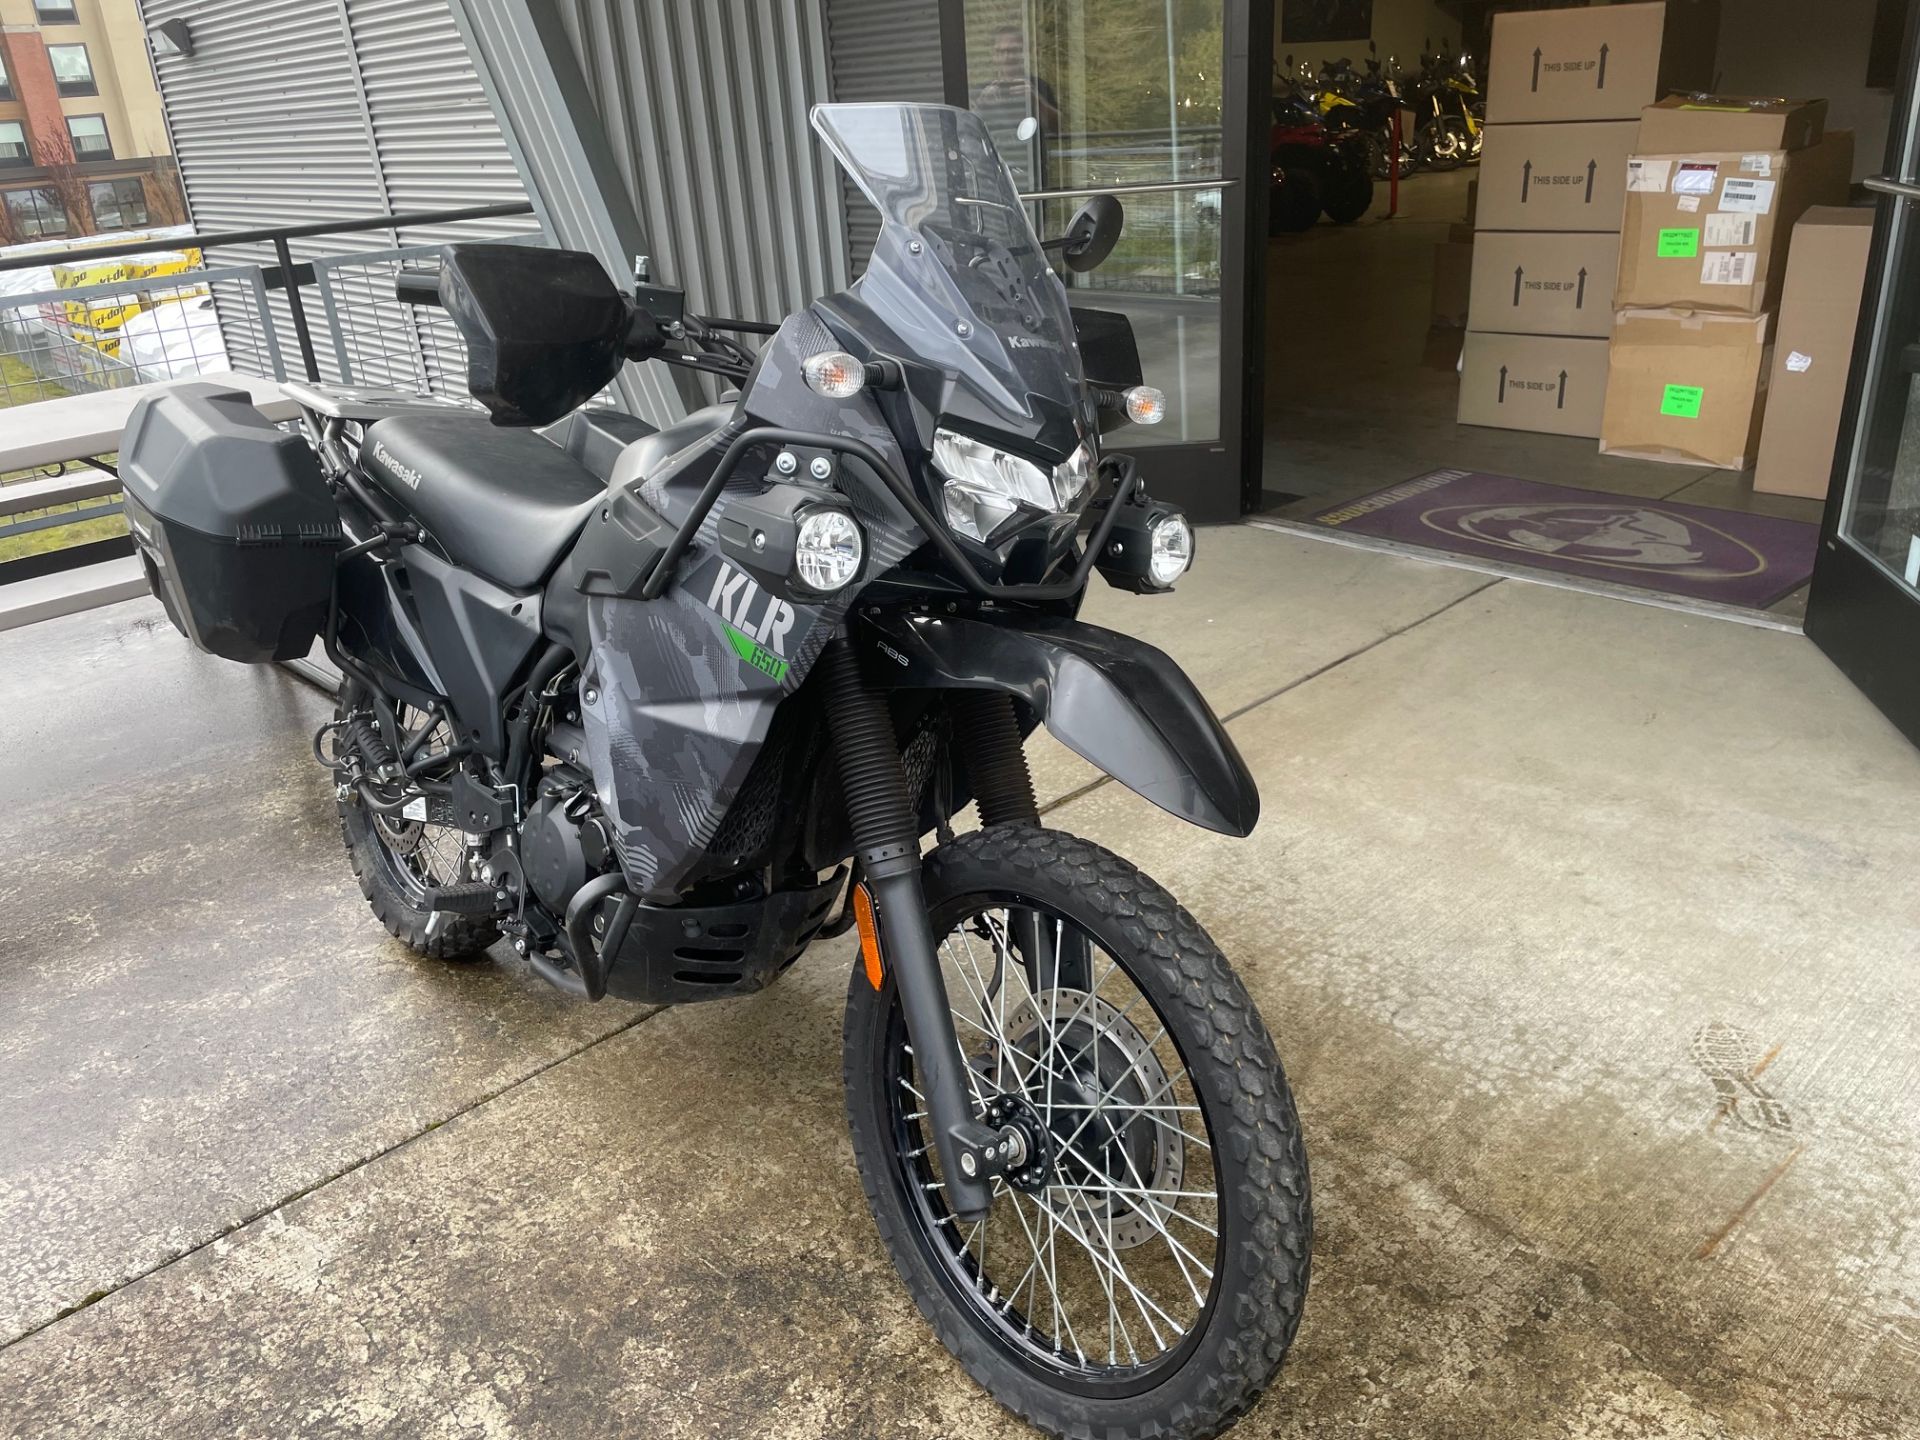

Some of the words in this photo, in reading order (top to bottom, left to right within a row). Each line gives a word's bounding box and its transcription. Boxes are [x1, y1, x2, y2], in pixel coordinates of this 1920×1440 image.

[1543, 63, 1561, 72] THIS
[1563, 61, 1583, 71] SIDE
[1584, 61, 1596, 70] UP
[1533, 176, 1551, 185] THIS
[1552, 176, 1571, 185] SIDE
[1572, 176, 1584, 185] UP
[1525, 281, 1542, 290] THIS
[1543, 281, 1562, 291] SIDE
[1563, 282, 1575, 291] UP
[1509, 380, 1526, 390] THIS
[1527, 381, 1545, 391] SIDE
[1545, 383, 1556, 391] UP
[372, 440, 422, 491] Kawasaki
[707, 562, 795, 657] KLR
[750, 646, 783, 678] 650
[877, 641, 909, 667] ABS
